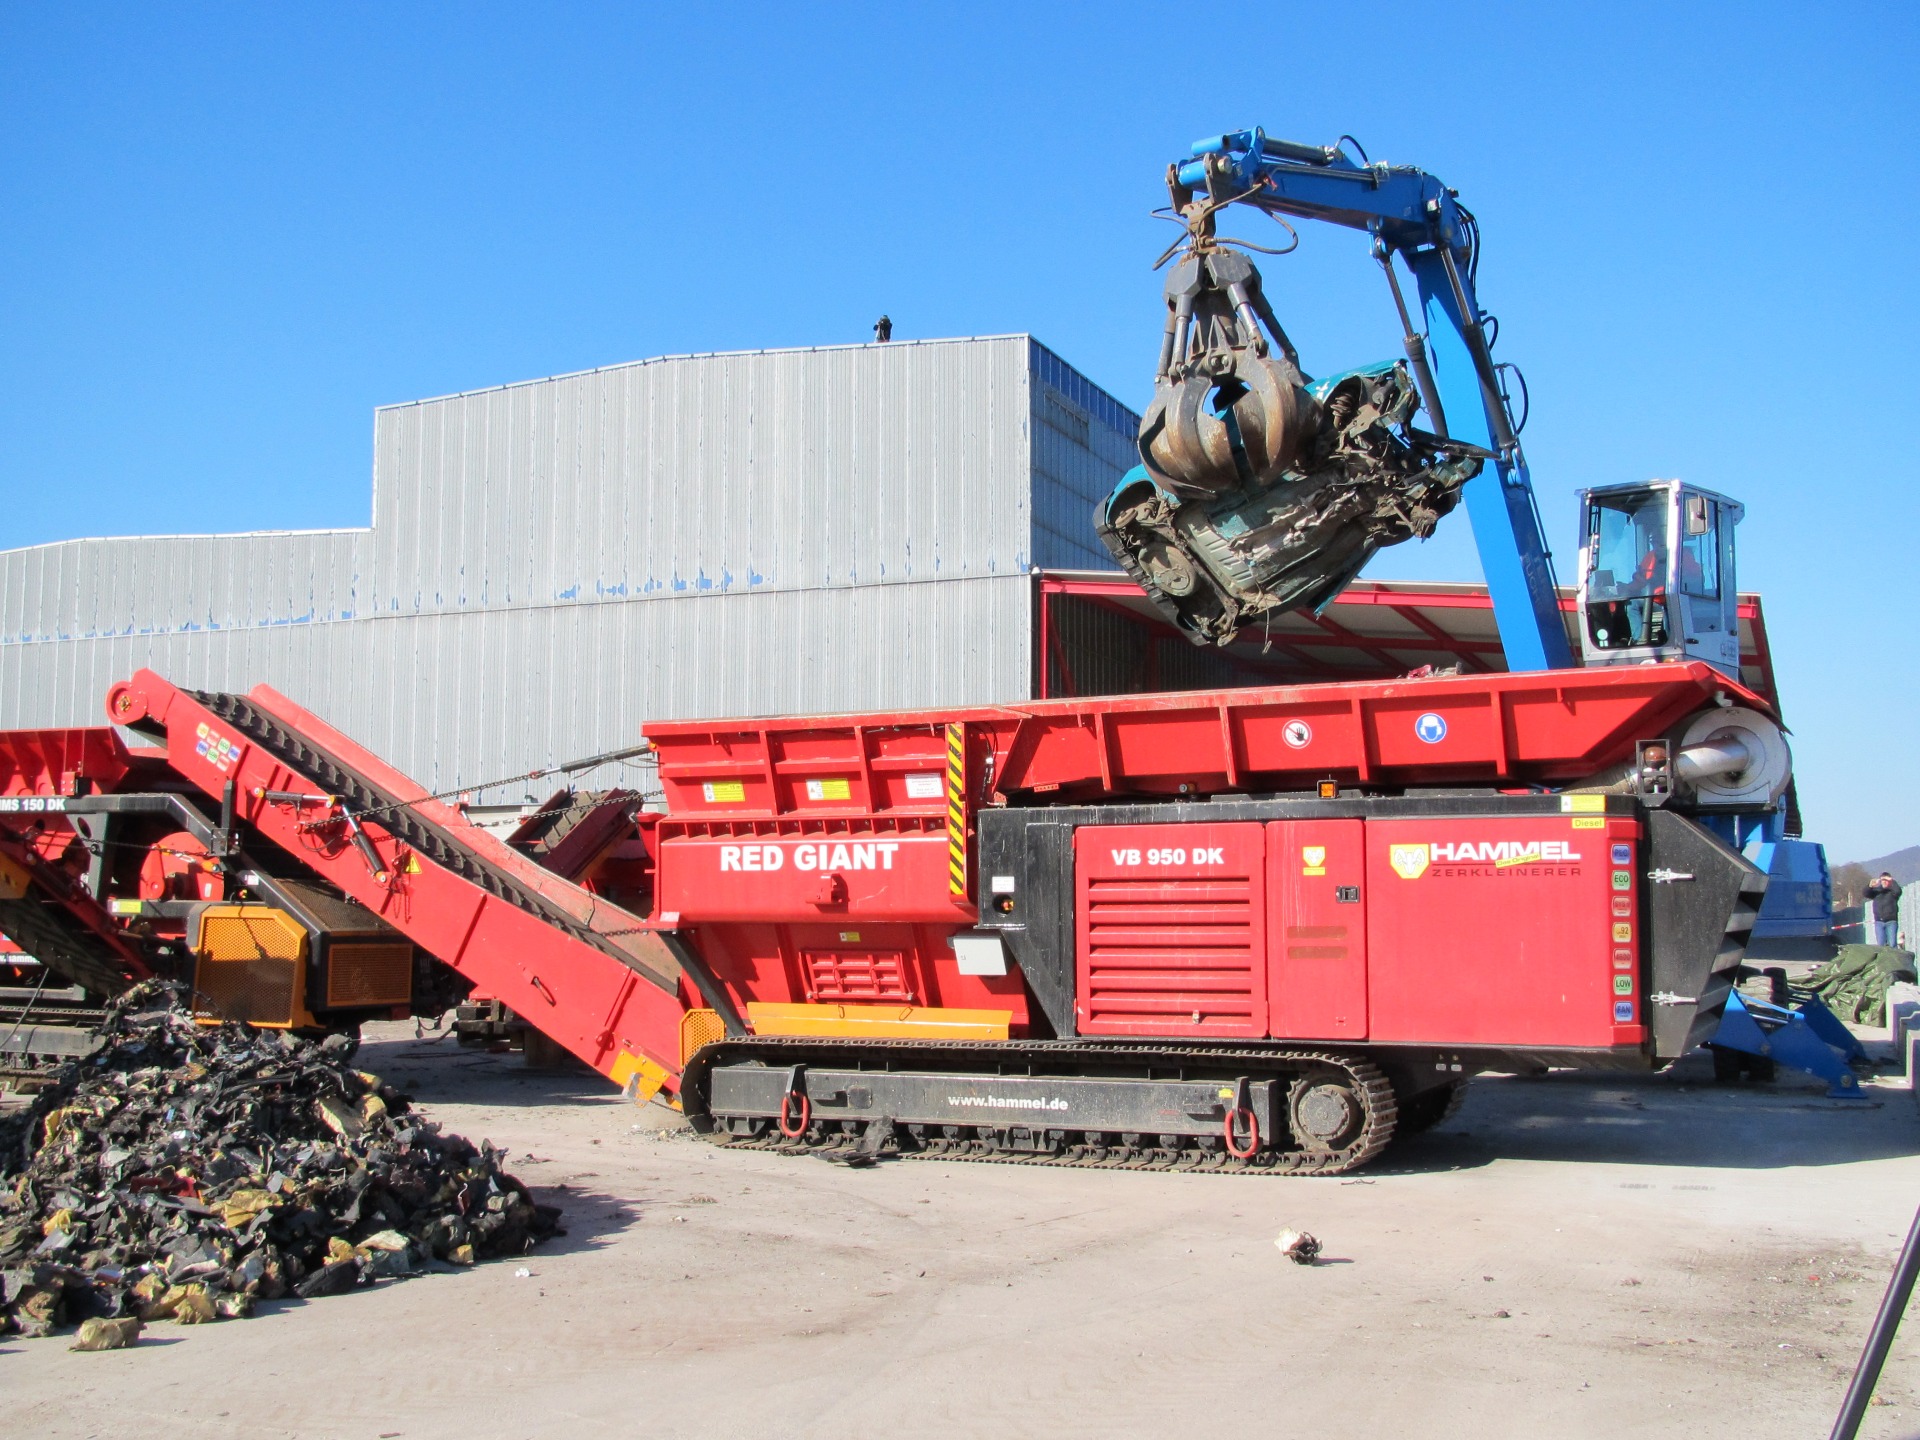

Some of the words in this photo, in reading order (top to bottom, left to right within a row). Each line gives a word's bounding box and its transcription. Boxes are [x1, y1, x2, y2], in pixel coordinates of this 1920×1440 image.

[0, 798, 19, 811] MS
[22, 798, 45, 811] 150
[47, 798, 66, 811] DK
[1574, 819, 1602, 827] Diesel
[1111, 848, 1142, 866] VB
[1147, 848, 1186, 866] 950
[1192, 847, 1225, 865] DK
[1430, 841, 1581, 861] HAMMEL
[720, 845, 784, 871] RED
[794, 843, 899, 871] GIANT
[1511, 854, 1540, 864] Original
[1432, 867, 1582, 877] ZERKLEINERER
[1614, 874, 1629, 883] ECO
[1615, 980, 1631, 988] LOW
[947, 1095, 1069, 1111] www.hammel.de
